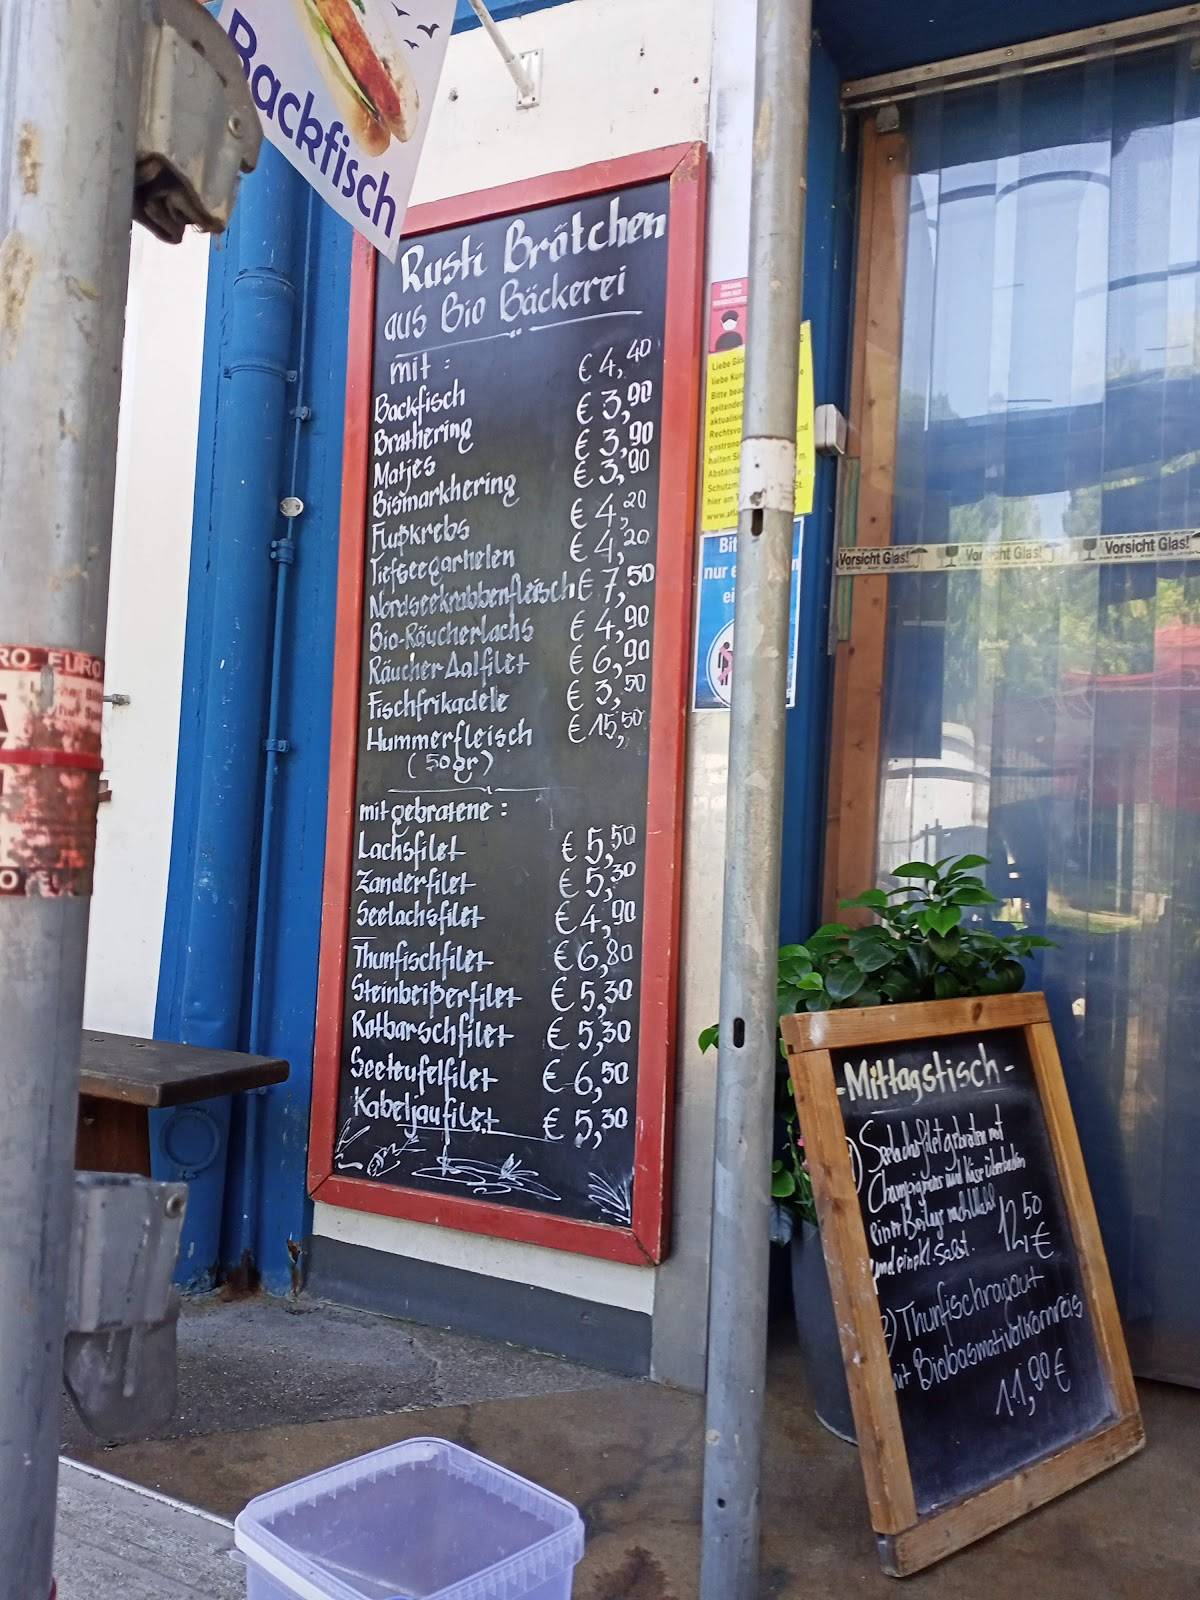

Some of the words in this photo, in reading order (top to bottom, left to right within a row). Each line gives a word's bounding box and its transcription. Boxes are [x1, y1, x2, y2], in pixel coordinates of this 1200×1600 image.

[228, 8, 397, 238] Backfisch
[401, 235, 488, 293] Rusti
[503, 196, 667, 274] Brötchen
[384, 305, 427, 342] aus
[441, 292, 486, 333] Bio
[500, 265, 627, 322] Bäckerei
[374, 379, 465, 426] Backfisch
[599, 338, 652, 379] 4,40
[389, 352, 431, 385] mit
[374, 417, 474, 454] Brathering
[601, 380, 652, 425] 3,90
[374, 455, 436, 494] Matjes
[599, 420, 653, 460] 3,90
[372, 473, 520, 518] Bismarkhering
[599, 449, 650, 486] 3,90
[371, 514, 470, 556] Flußkrebs
[594, 489, 647, 530] 4,20
[1105, 538, 1155, 554] Vorsicht
[1158, 535, 1190, 552] Glas!
[594, 529, 650, 565] 4,20
[839, 551, 881, 566] Vorsicht
[601, 563, 655, 609] 7,50
[704, 565, 728, 580] nur
[594, 604, 650, 644] 4,90
[592, 638, 650, 679] 6,90
[595, 673, 646, 710] 3,50
[366, 716, 533, 754] Hummerfleisch
[359, 800, 388, 822] mit
[391, 796, 493, 838] gebratene
[358, 829, 466, 871] Lachsfilet
[585, 824, 636, 870] 5,50
[355, 867, 477, 904] Zanderfilet
[585, 861, 637, 903] 5,30
[356, 899, 485, 935] Seelachsfilet
[580, 899, 637, 939] 4,90
[352, 940, 494, 981] Thunfischfilet
[577, 938, 633, 979] 6,80
[351, 973, 523, 1023] Steinbeißerfilet
[581, 978, 633, 1020] 5,30
[351, 1009, 515, 1058] Rotbarschfilet
[578, 1019, 632, 1056] 5,30
[350, 1045, 499, 1100] Seeteufelfilet
[573, 1060, 629, 1104] 6,50
[354, 1086, 500, 1143] Kabeljaufilet
[574, 1107, 628, 1149] 5,30
